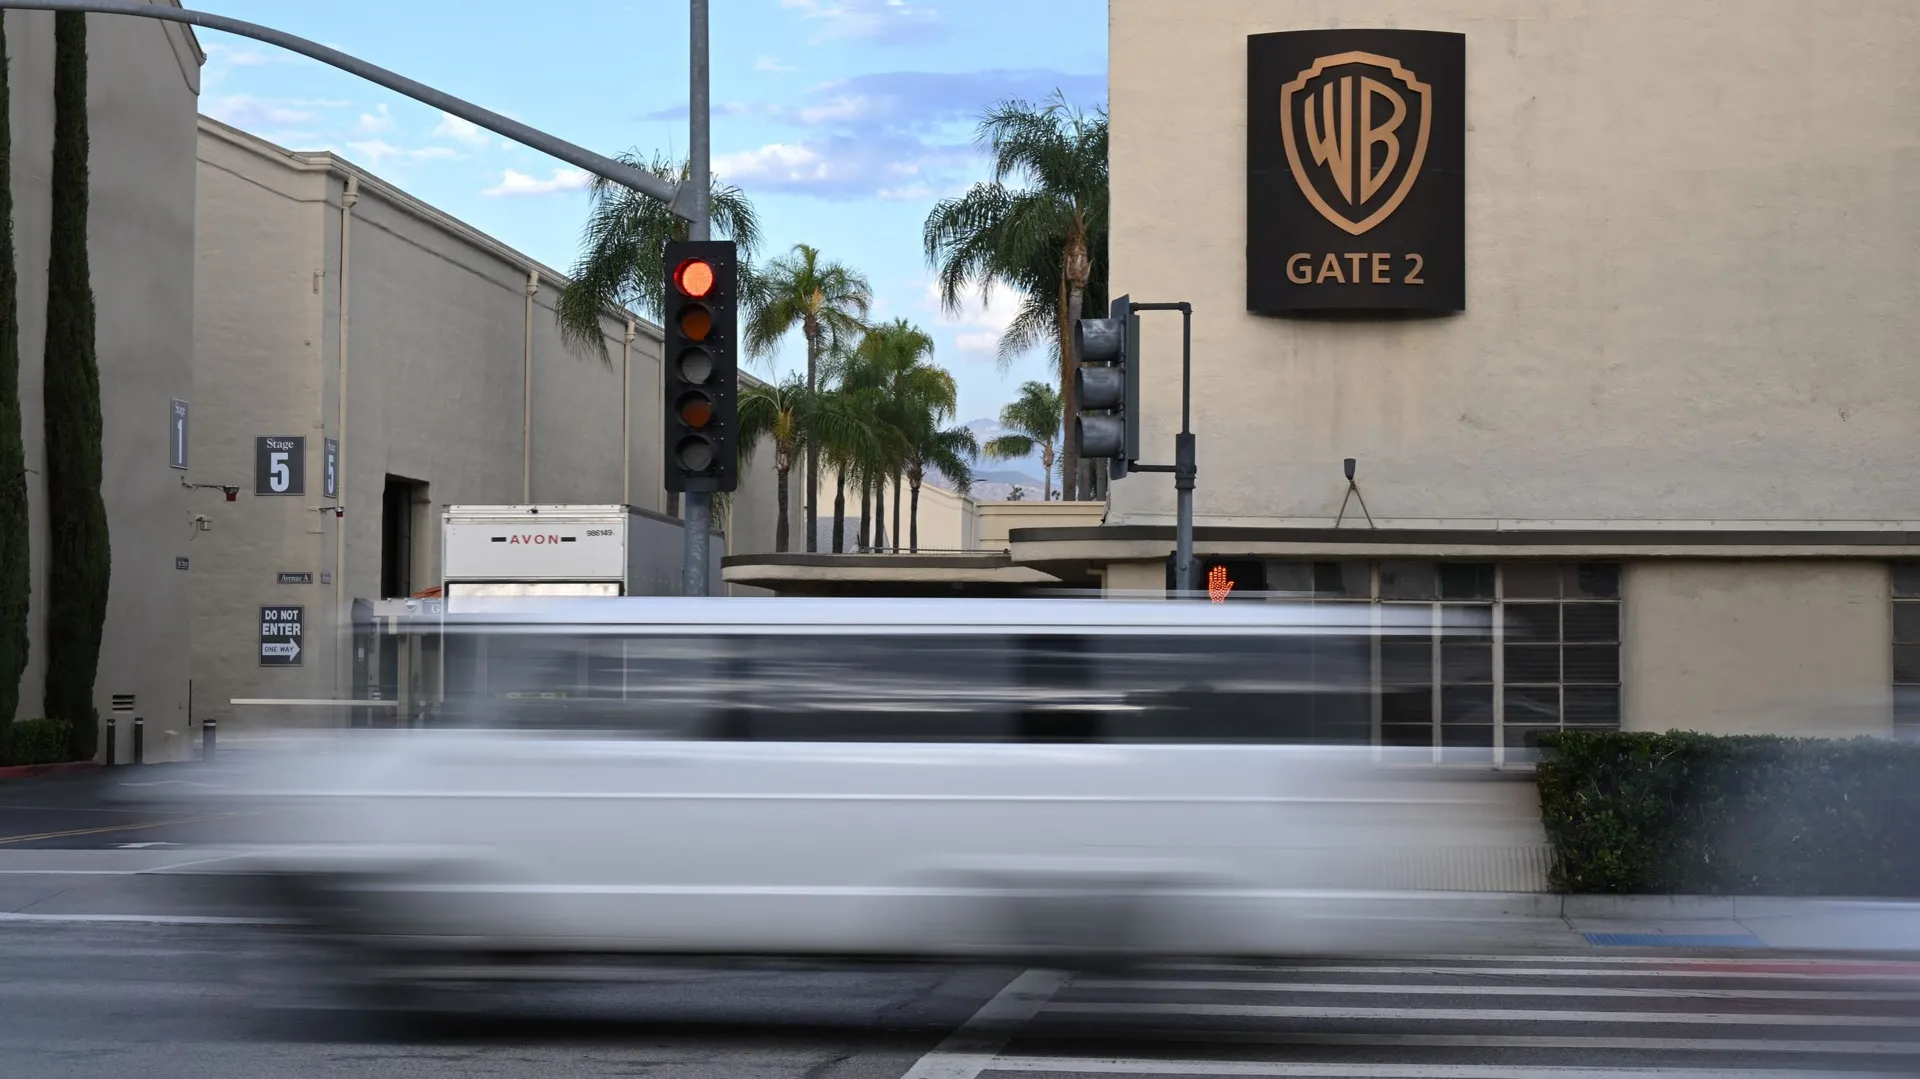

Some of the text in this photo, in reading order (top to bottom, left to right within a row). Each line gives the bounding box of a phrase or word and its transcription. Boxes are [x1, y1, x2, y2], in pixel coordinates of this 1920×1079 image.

[1304, 75, 1407, 206] WB
[1286, 252, 1425, 285] GATE 2
[177, 418, 183, 464] 1
[266, 437, 294, 450] Stage
[269, 452, 290, 492] 5
[328, 454, 334, 494] 5
[510, 534, 559, 545] AVON
[281, 574, 309, 582] Avenue A
[265, 609, 299, 621] DO NOT
[262, 622, 301, 636] ENTER
